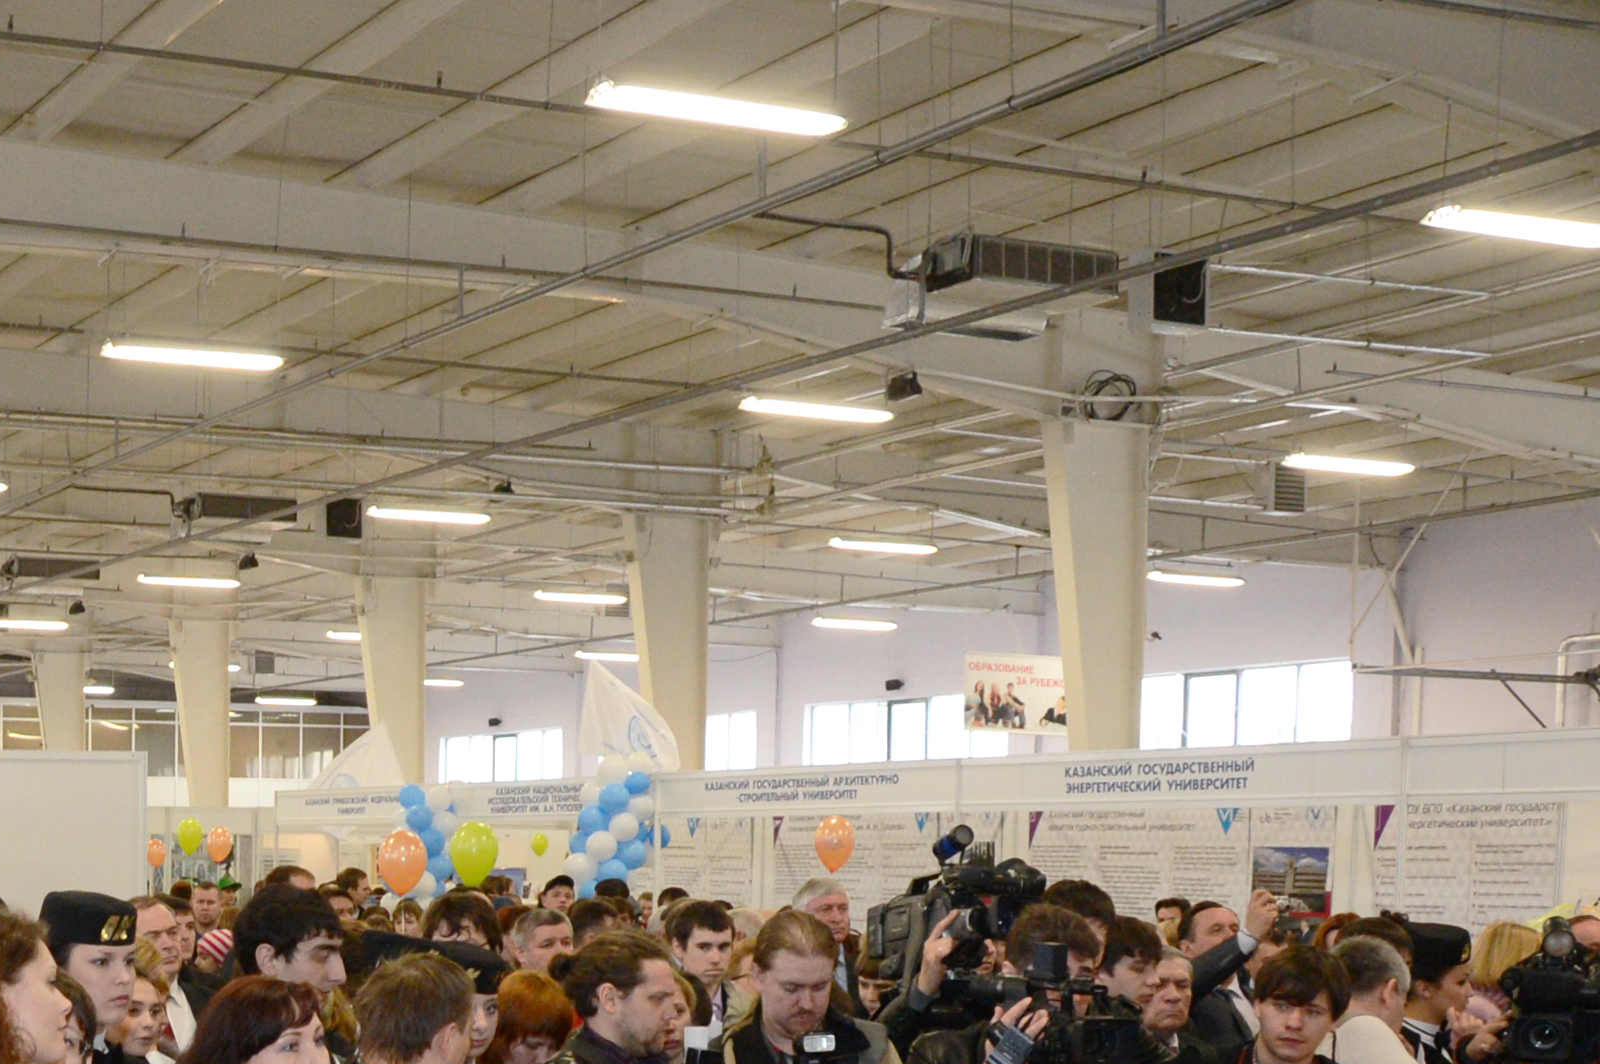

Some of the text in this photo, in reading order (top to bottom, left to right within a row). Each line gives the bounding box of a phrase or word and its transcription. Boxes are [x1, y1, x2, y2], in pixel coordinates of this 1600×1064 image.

[968, 661, 1035, 674] ОБРАЗОВАНИЕ
[1016, 676, 1028, 686] ЗА
[1064, 758, 1255, 778] КАЗАНСКИЙ ГОСУДАРСТВЕННЫЙ
[704, 774, 900, 792] КАЗАНСКИЙ ГОСУДАРСТВЕННЫЙ АРХИТЕКТУРНО
[1065, 777, 1249, 794] ЭНЕРГЕТИЧЕСКИЙ УНИВЕРСИТЕТ
[802, 789, 858, 801] УНИВЕРСИТЕТ
